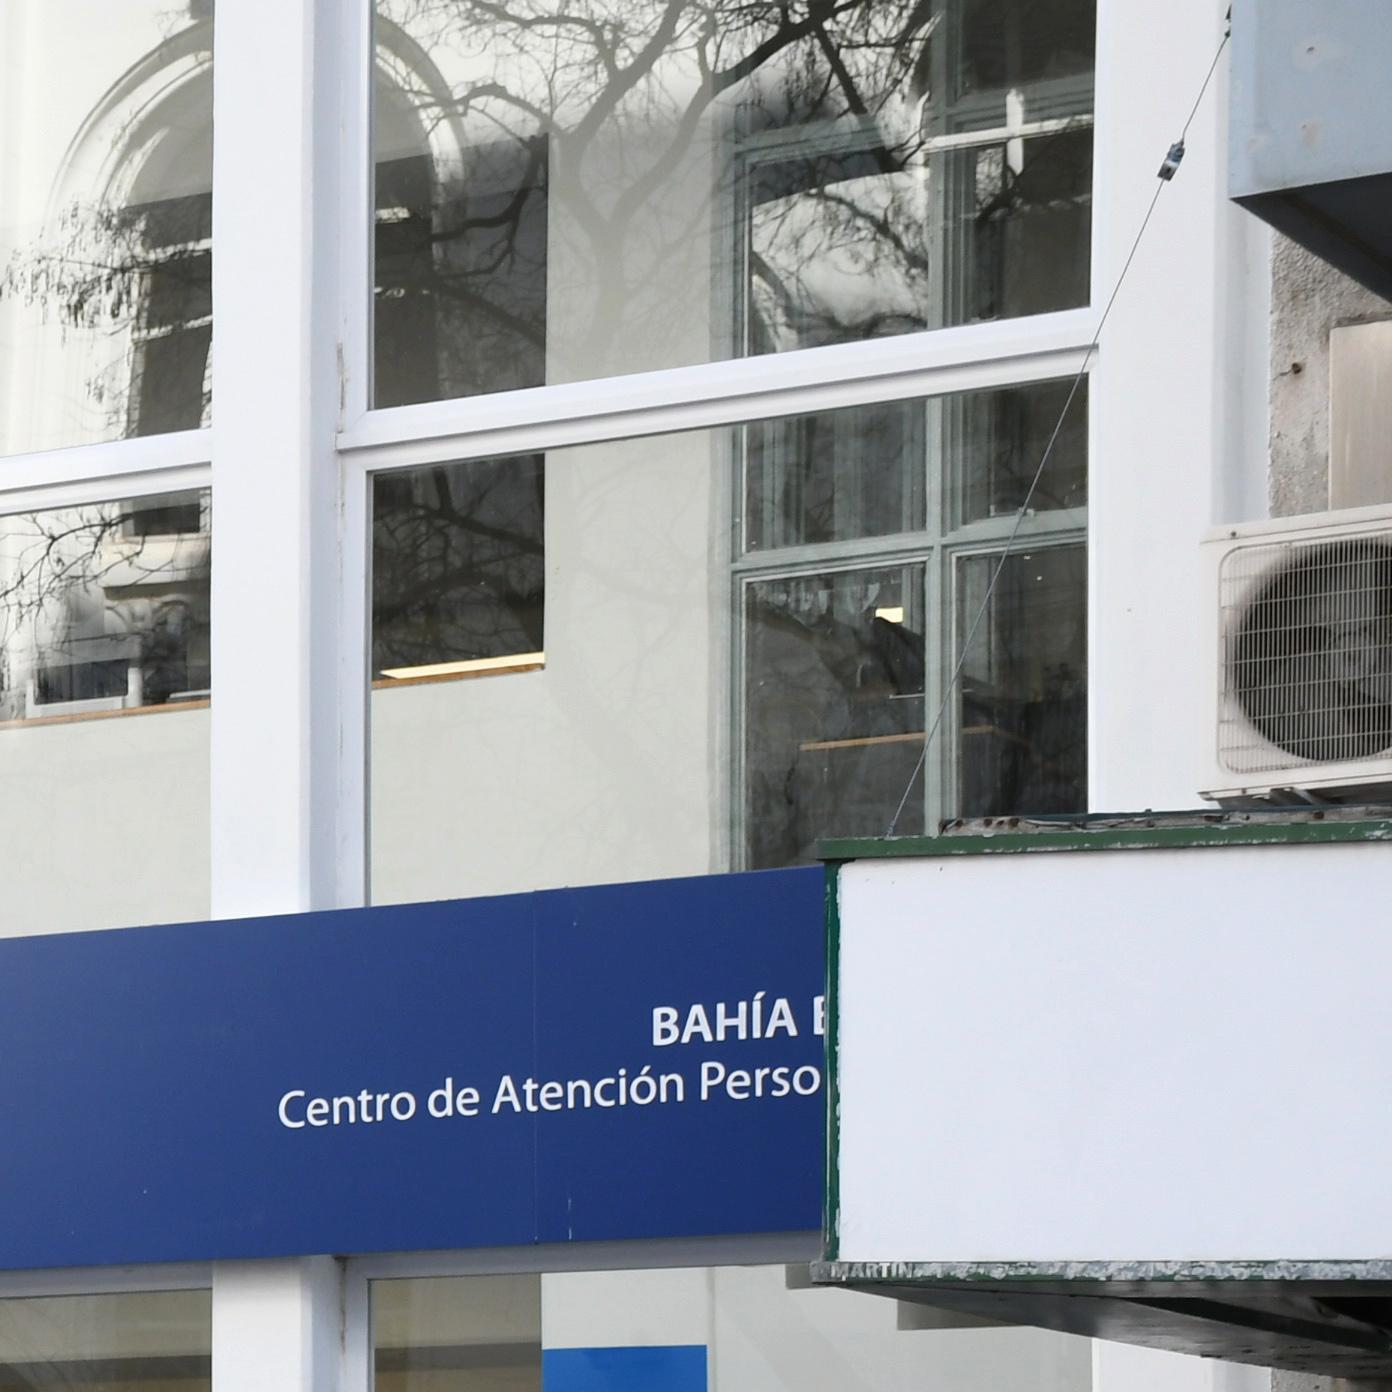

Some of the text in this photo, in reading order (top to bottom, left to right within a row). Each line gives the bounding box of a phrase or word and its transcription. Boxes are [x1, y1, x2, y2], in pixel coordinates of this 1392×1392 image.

[651, 991, 798, 1046] BAHÍA
[277, 1089, 417, 1129] Centro
[427, 1076, 480, 1118] de
[490, 1064, 684, 1114] Atención
